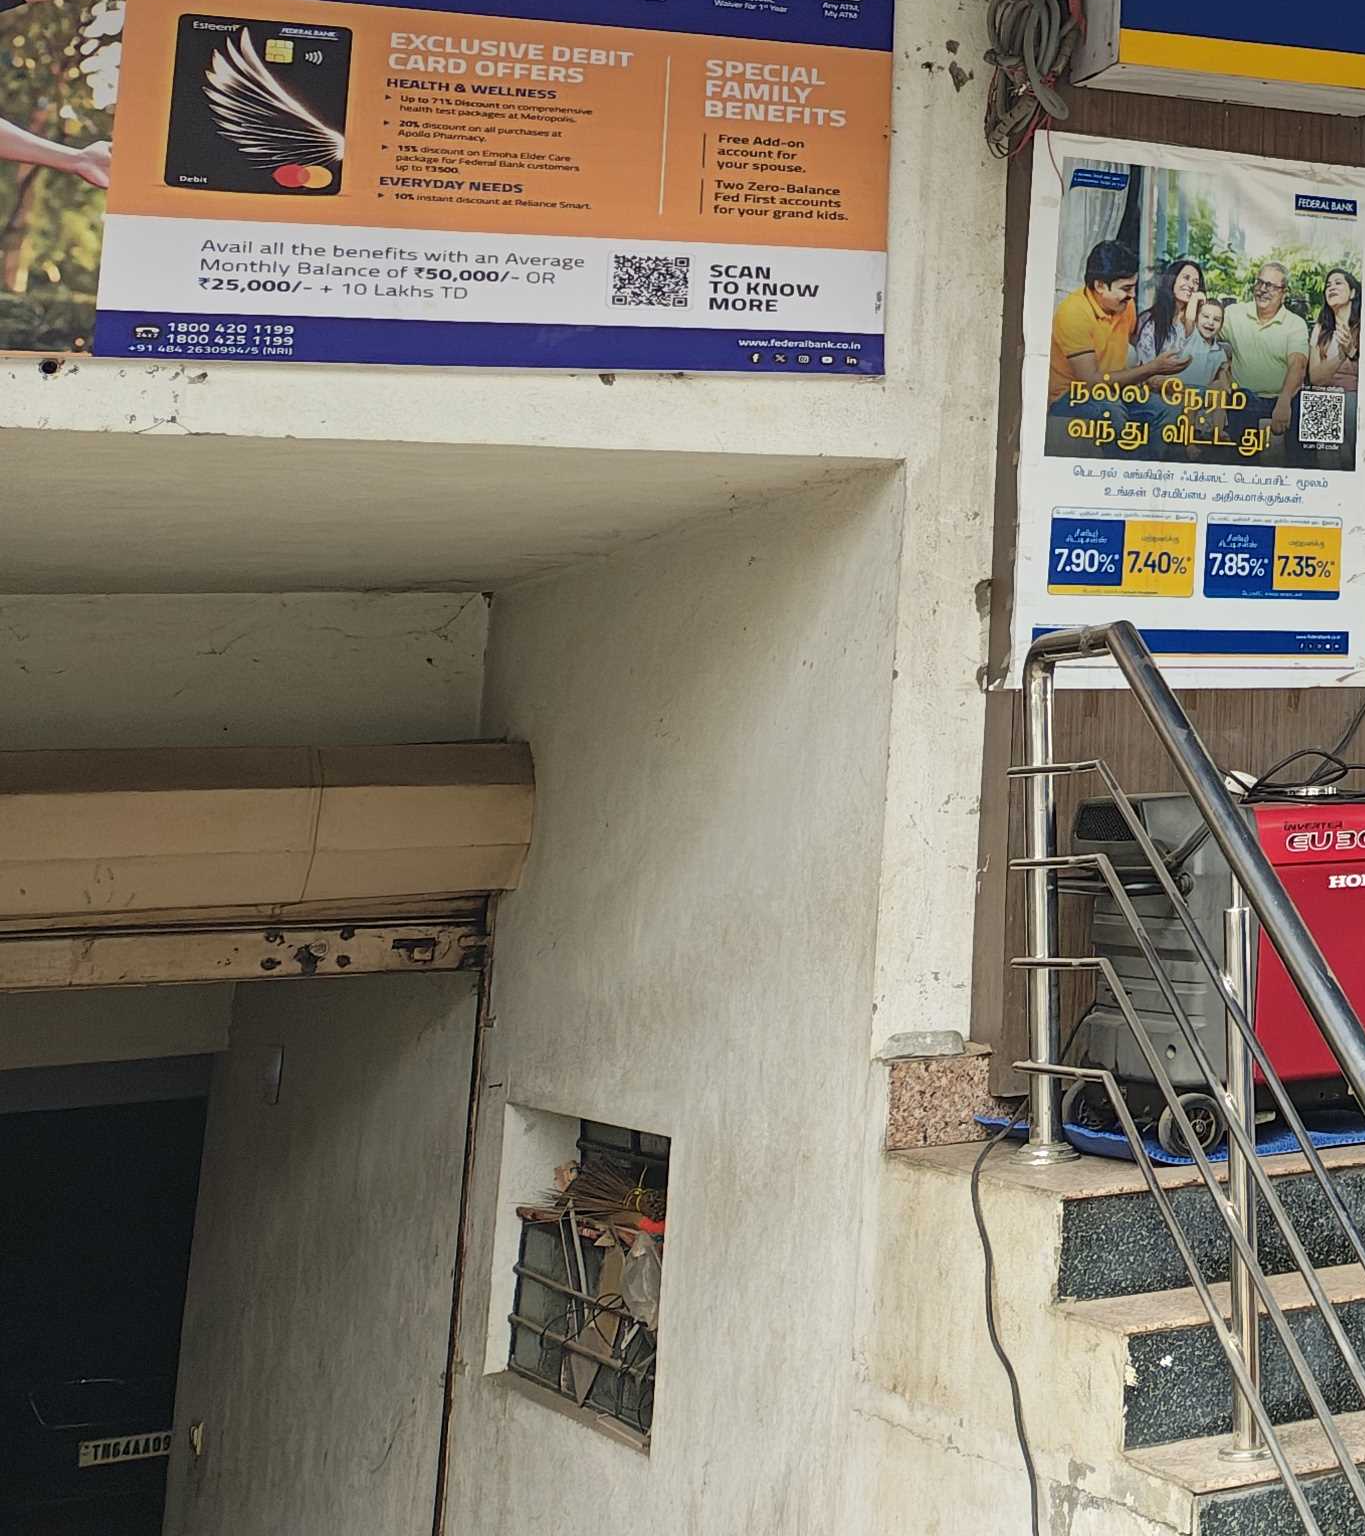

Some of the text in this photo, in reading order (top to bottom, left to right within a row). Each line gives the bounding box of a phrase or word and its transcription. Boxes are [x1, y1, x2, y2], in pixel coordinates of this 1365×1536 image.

[390, 31, 635, 67] EXCLUSIVE DEBIT
[387, 53, 585, 84] CARD OFFERS
[705, 59, 826, 86] SPECIAL
[386, 78, 557, 100] HEALTH & WELLNESS
[705, 79, 813, 105] FAMILY
[704, 99, 847, 128] BENEFITS
[718, 134, 805, 149] Free Add-on
[717, 147, 797, 160] account for
[717, 160, 806, 173] your spouse.
[179, 173, 208, 185] Debit
[379, 176, 524, 194] EVERYDAY NEEDS
[200, 239, 585, 270] Avail all the benefits with an Average
[200, 258, 556, 284] Monthly Balance of ₹50,000/- OR
[709, 264, 771, 280] SCAN
[198, 277, 468, 300] ₹25,000/- + 10 Lakhs TD
[709, 280, 820, 297] TO KNOW
[709, 297, 779, 312] MORE
[167, 322, 294, 334] 1800 420 1199
[738, 339, 862, 350] www.federalbank.co.in
[1069, 374, 1248, 414] நல்ல நேரம்
[1067, 411, 1149, 451] வந்து
